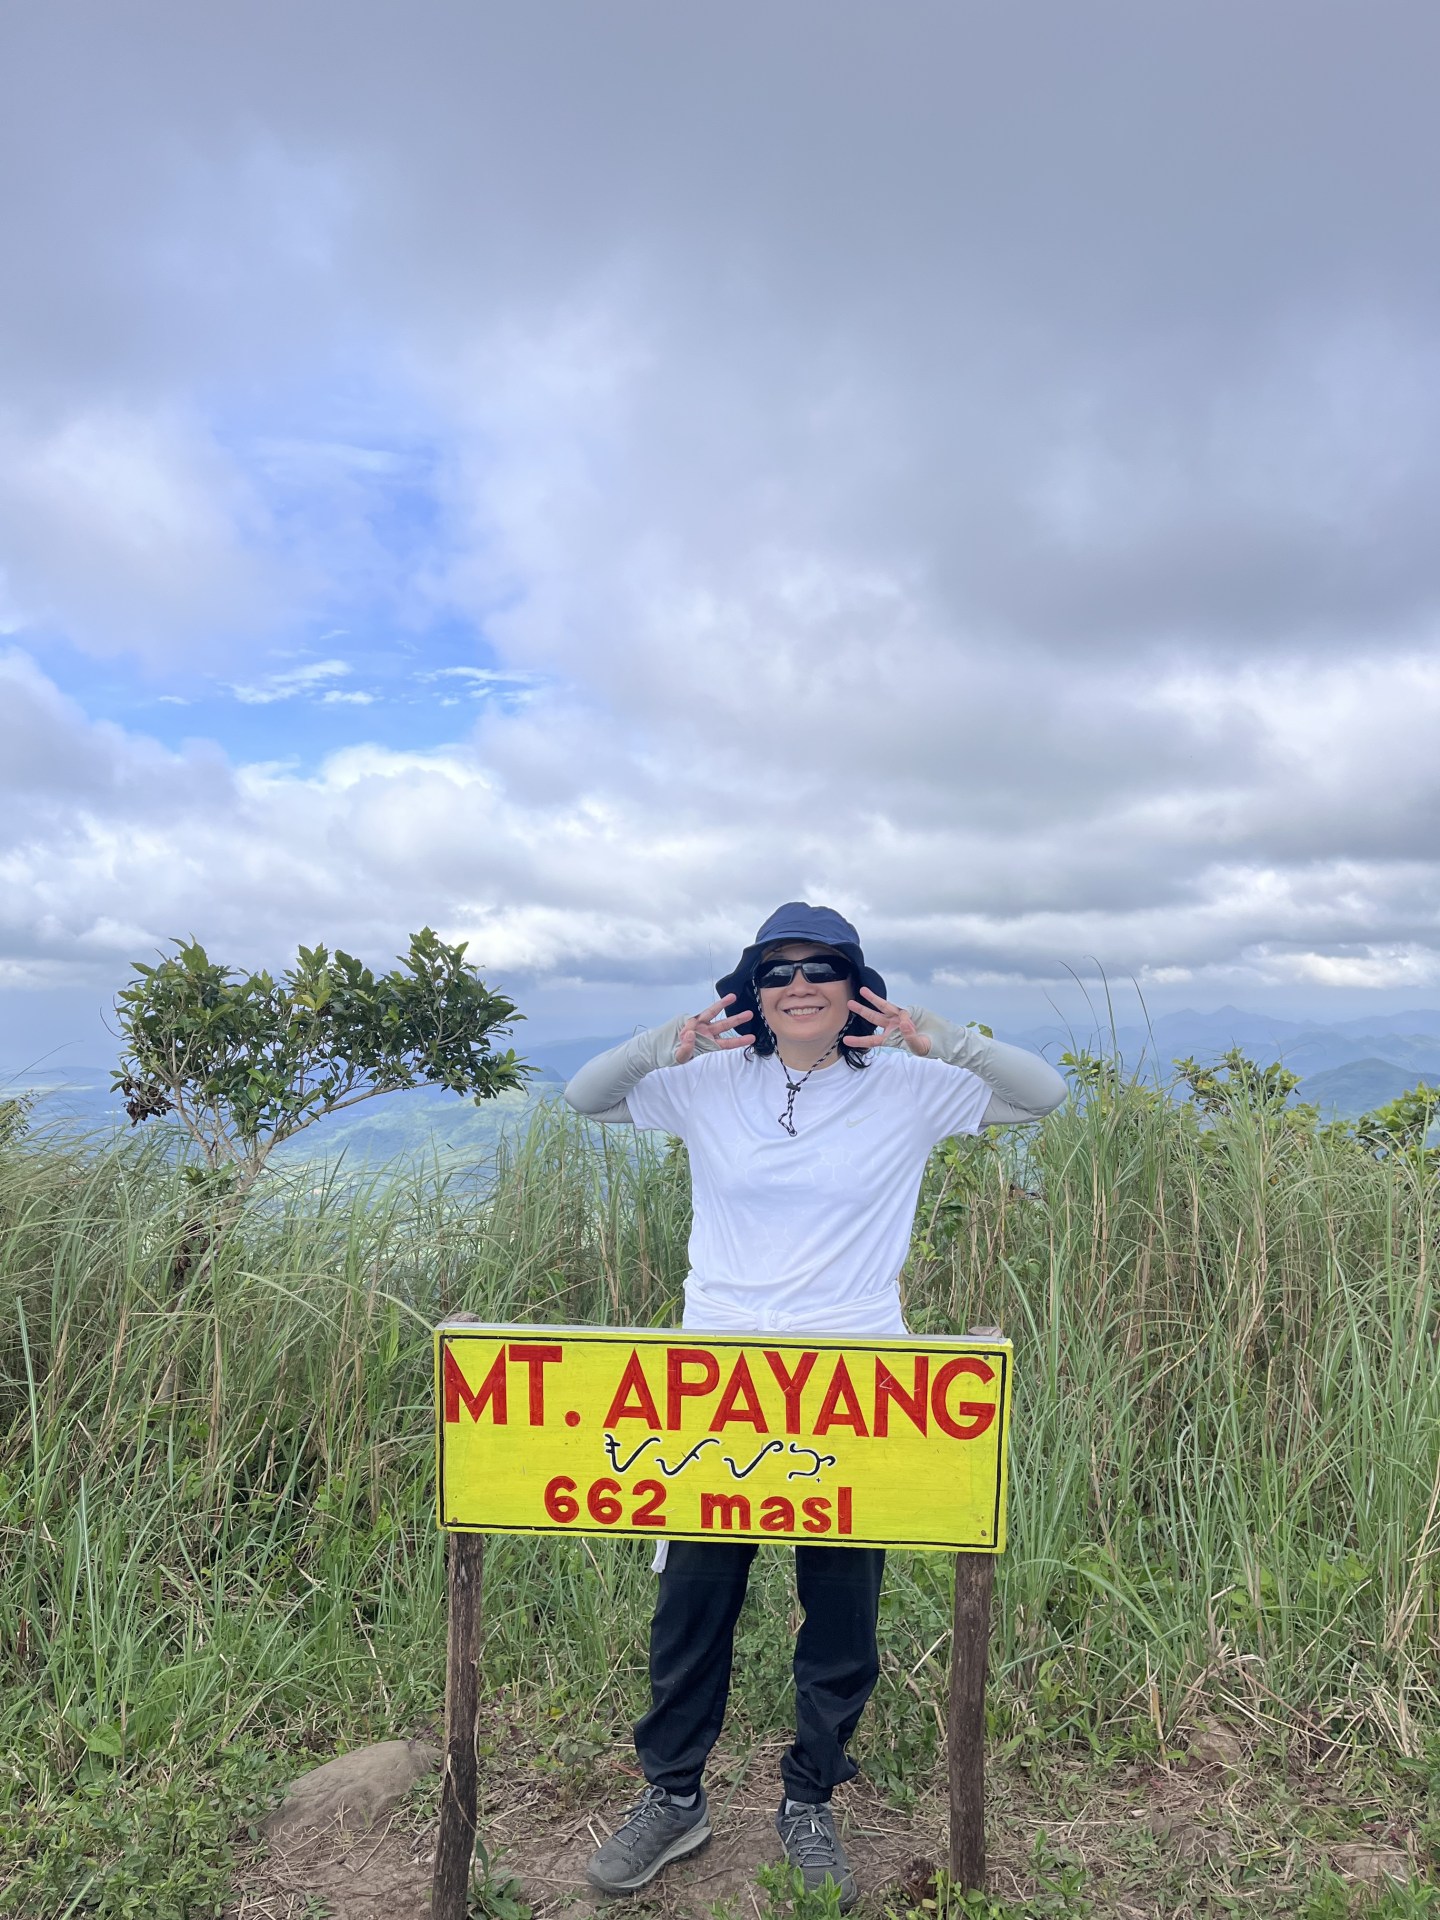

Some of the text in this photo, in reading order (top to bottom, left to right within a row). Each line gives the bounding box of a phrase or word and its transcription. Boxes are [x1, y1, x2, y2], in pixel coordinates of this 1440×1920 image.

[444, 1344, 996, 1441] MT. APAYANG
[543, 1475, 853, 1535] 662 masl
